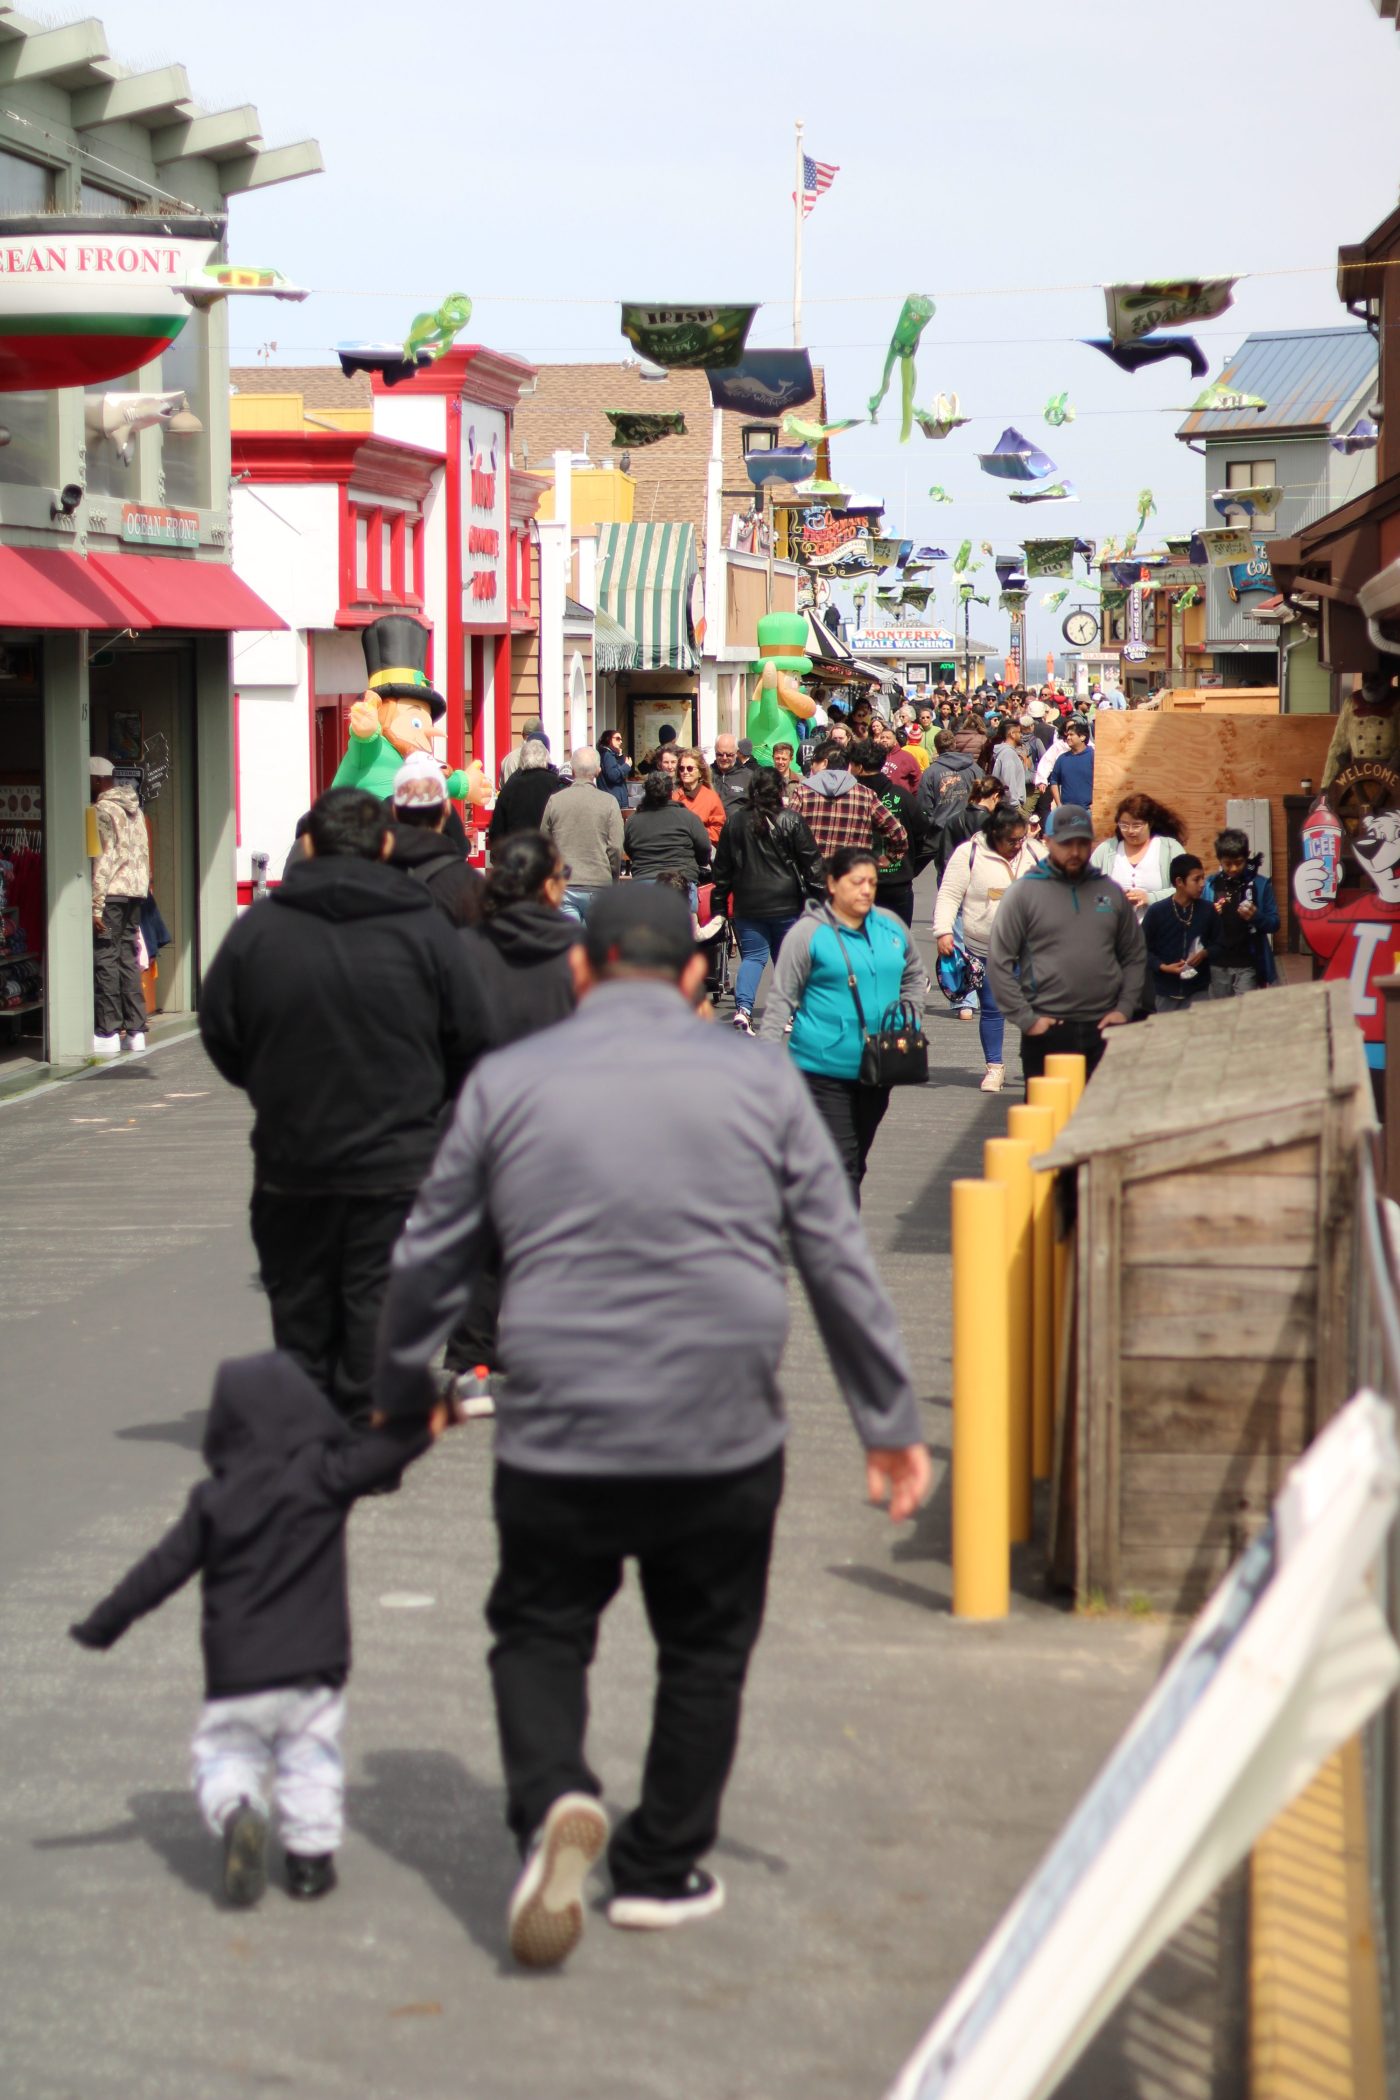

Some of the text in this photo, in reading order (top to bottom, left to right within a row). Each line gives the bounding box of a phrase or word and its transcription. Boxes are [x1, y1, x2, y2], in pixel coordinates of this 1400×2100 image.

[77, 247, 181, 274] FRONT
[646, 309, 714, 325] IRISH
[127, 513, 197, 541] OCEAN FRONT
[854, 640, 951, 649] WHALE WATCHING
[865, 630, 942, 640] MONTEREY
[1336, 762, 1400, 787] WELCOME
[1309, 836, 1336, 857] ICEE
